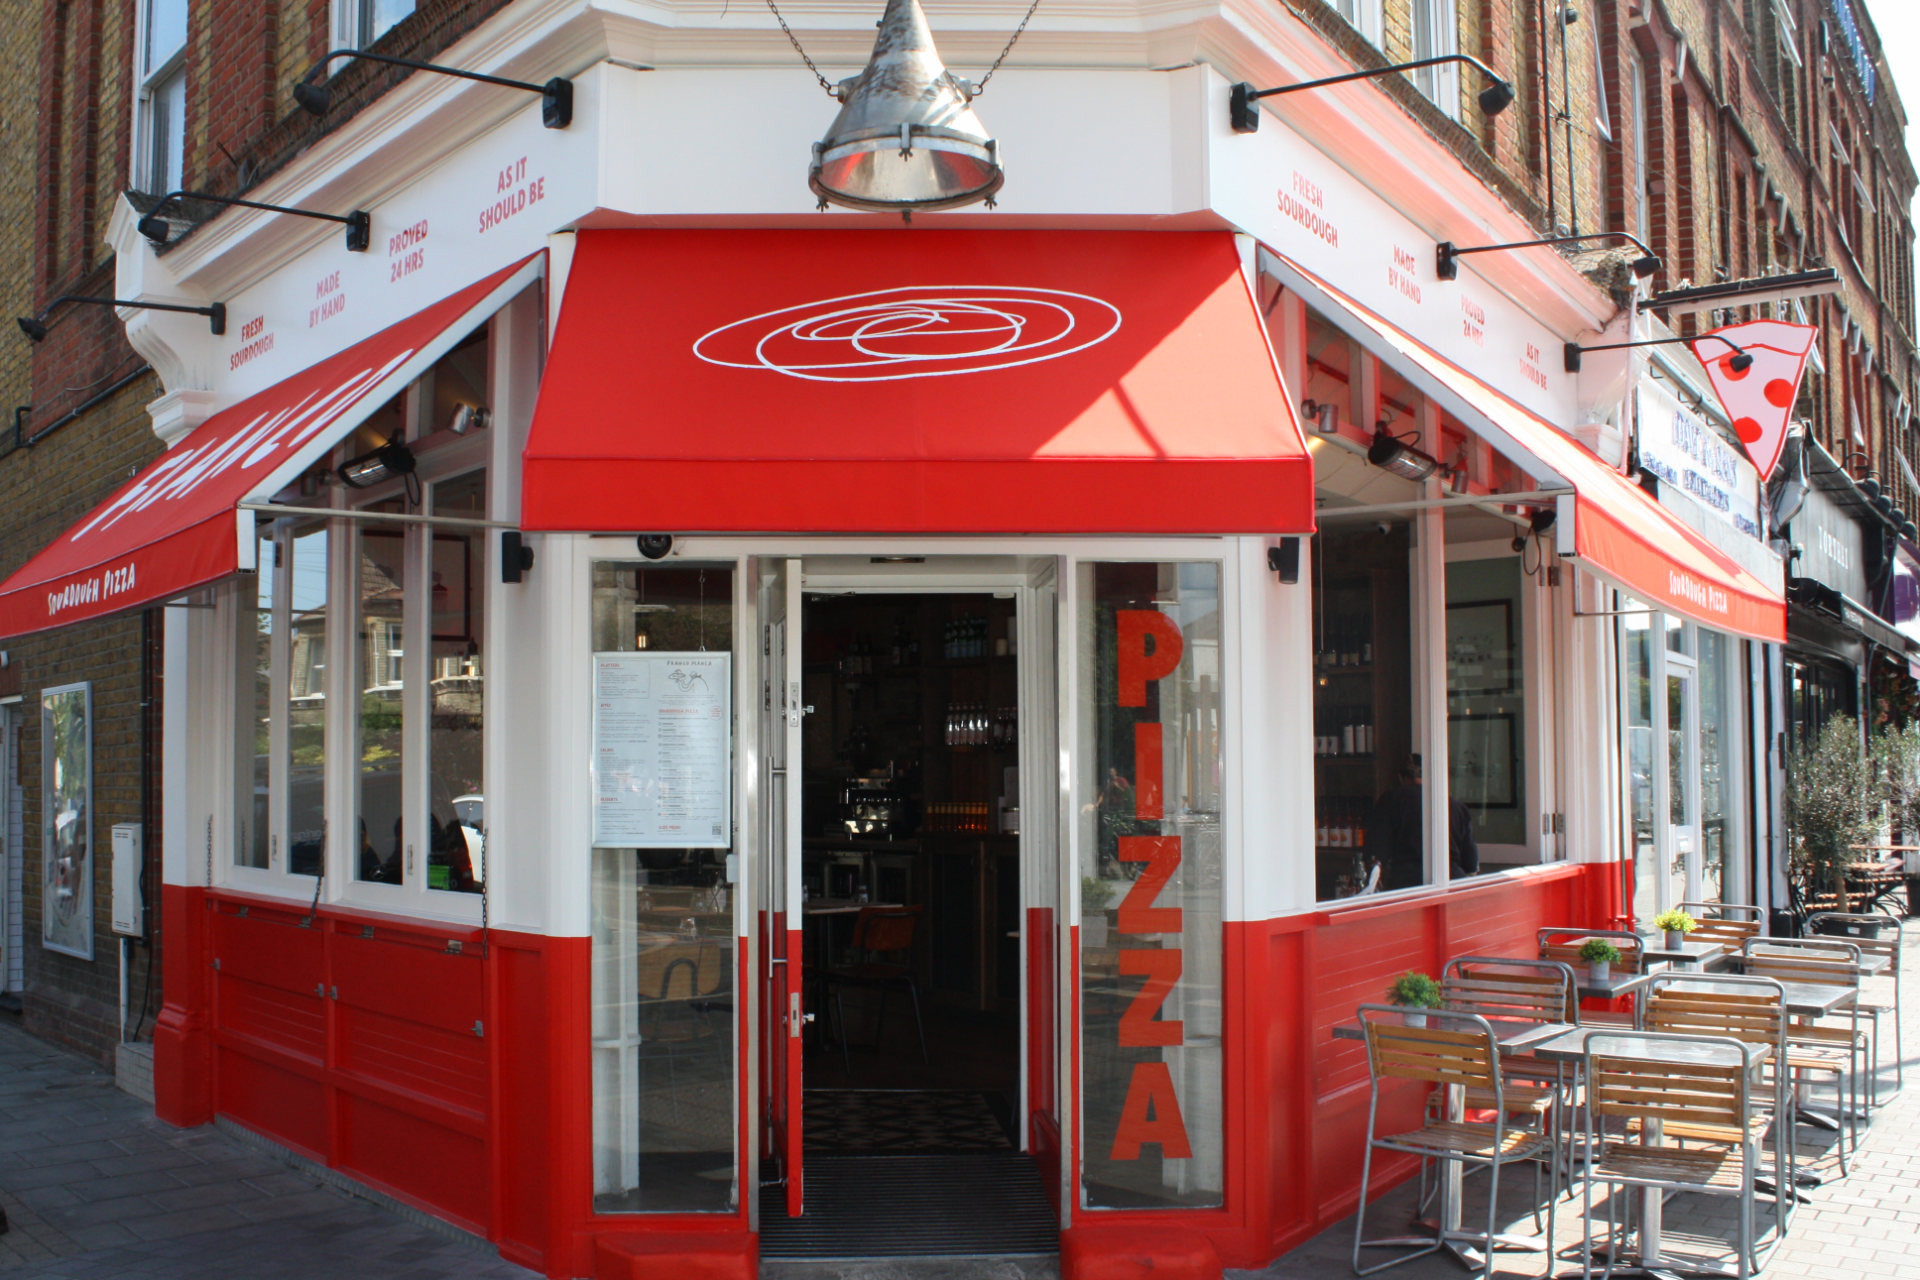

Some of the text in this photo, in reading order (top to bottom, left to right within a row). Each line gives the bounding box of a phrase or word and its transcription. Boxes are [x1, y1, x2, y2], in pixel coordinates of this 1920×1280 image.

[497, 156, 528, 194] AS IT
[1292, 170, 1323, 210] FRESH
[479, 176, 545, 234] SHOULD BE
[1277, 188, 1339, 249] SOURDOUGH
[389, 218, 428, 257] PROVED
[390, 247, 424, 284] 24 HRS
[1393, 244, 1416, 277] MADE
[316, 270, 341, 300] MADE
[1388, 266, 1422, 305] BY HAND
[241, 314, 264, 343] FRESH
[309, 293, 346, 329] BY HAND
[1461, 293, 1486, 326] PROVED
[1463, 319, 1471, 339] 24
[230, 333, 275, 371] SOURDOUGH
[1526, 342, 1540, 364] AS IT
[1519, 357, 1548, 391] SHOULD BE
[47, 562, 136, 617] SOURDOUGH PIZZA
[1669, 569, 1728, 614] SOURDOUGH PIZZA
[1109, 609, 1194, 1161] PIZZA
